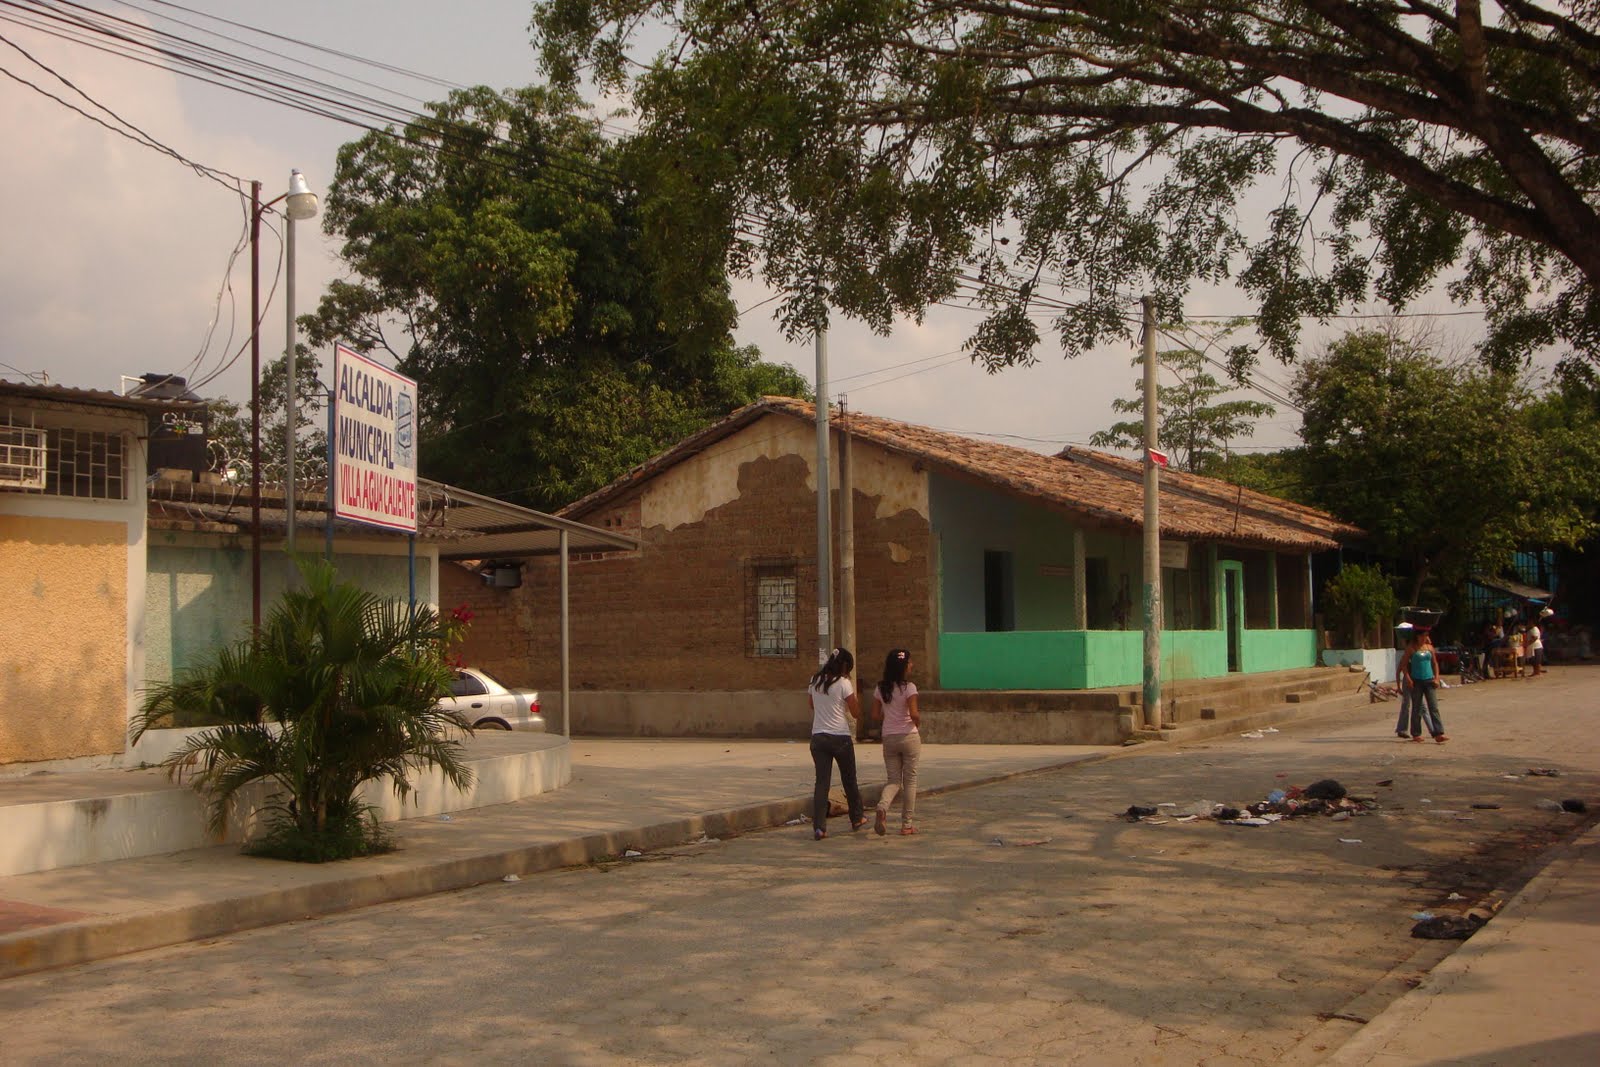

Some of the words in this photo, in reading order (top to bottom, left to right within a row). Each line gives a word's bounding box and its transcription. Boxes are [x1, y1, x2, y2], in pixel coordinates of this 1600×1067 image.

[339, 364, 394, 420] ALCALDIA
[338, 415, 394, 470] MUNICIPAL
[340, 463, 362, 508] VILLA
[362, 469, 383, 512] AGUA
[384, 475, 415, 519] CALIENTE
